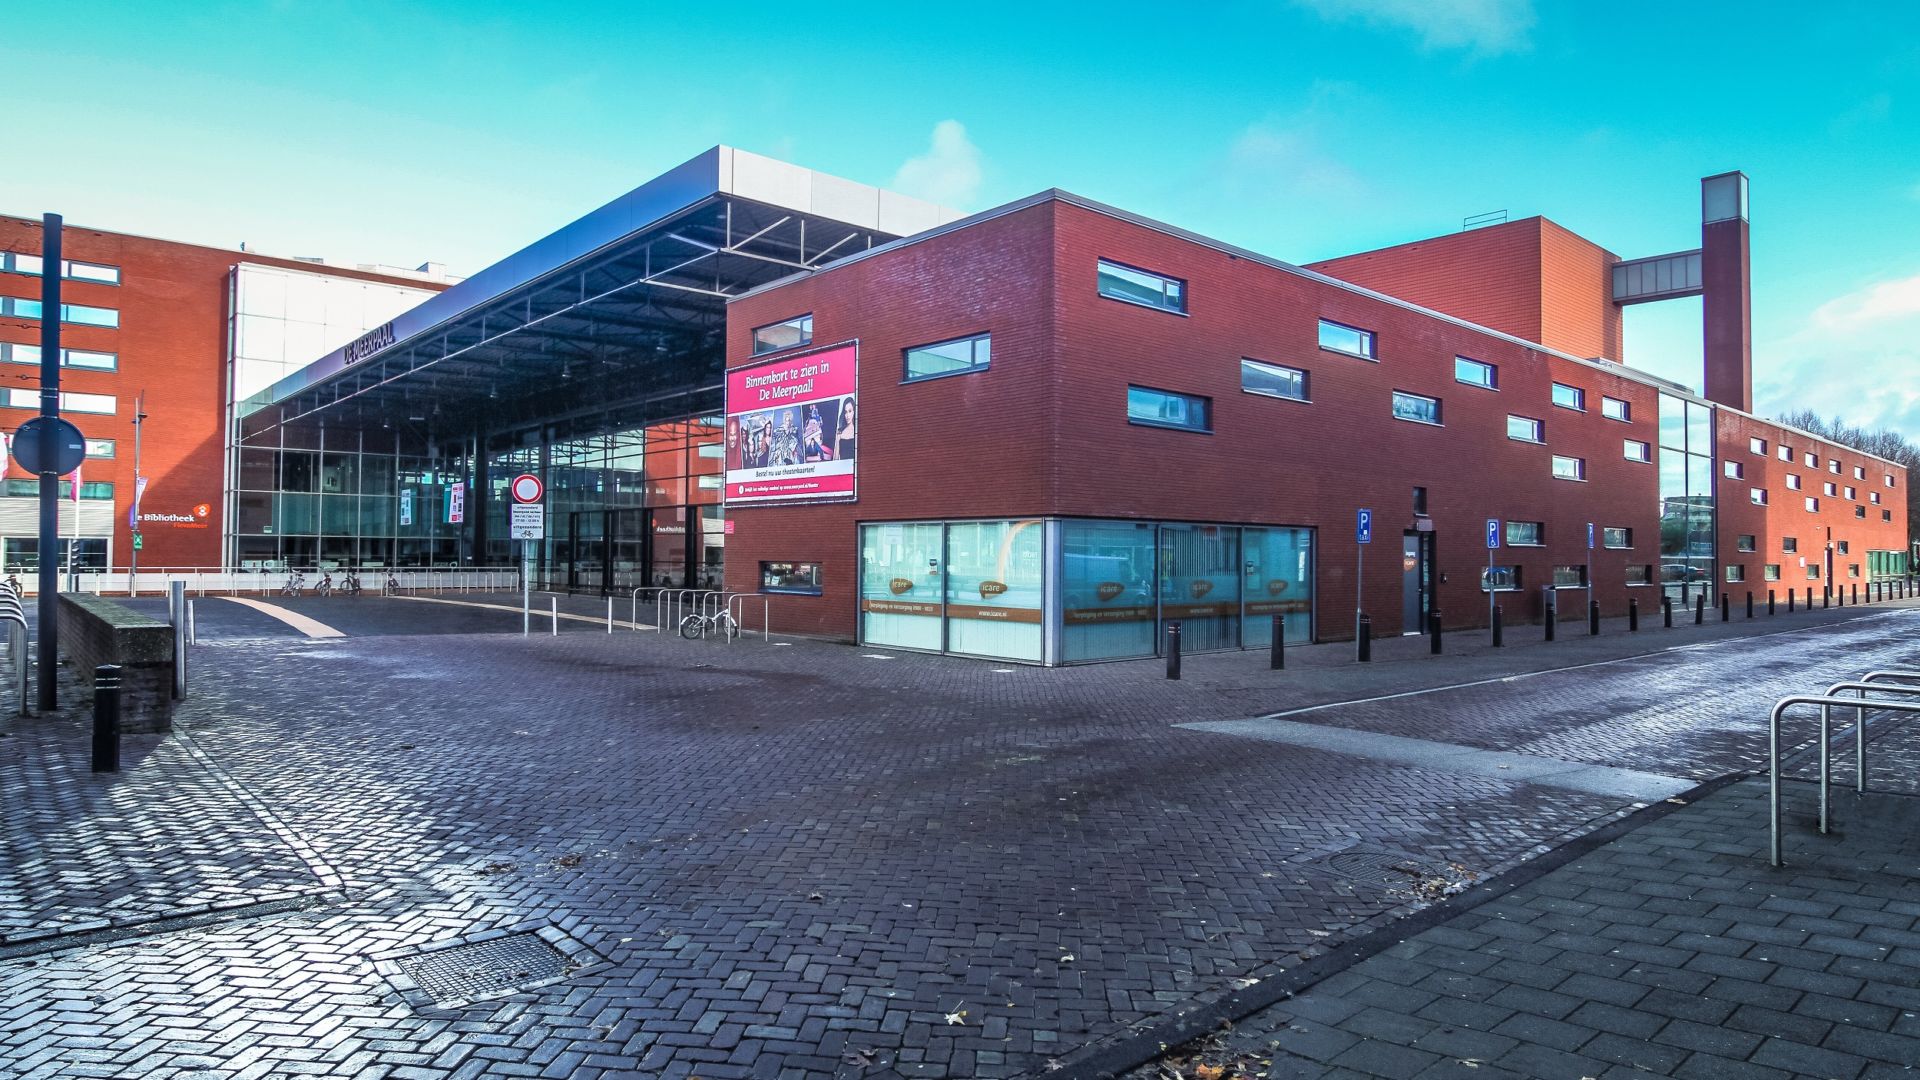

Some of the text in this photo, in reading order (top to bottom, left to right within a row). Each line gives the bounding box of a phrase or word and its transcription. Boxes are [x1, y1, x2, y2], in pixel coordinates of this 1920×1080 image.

[353, 321, 395, 360] MEERPAAL
[745, 360, 830, 388] Binnenkort te zien in
[759, 379, 814, 400] De Meerpaal!
[144, 514, 195, 522] Bibliotheek
[1361, 513, 1368, 529] P
[1489, 522, 1496, 536] P
